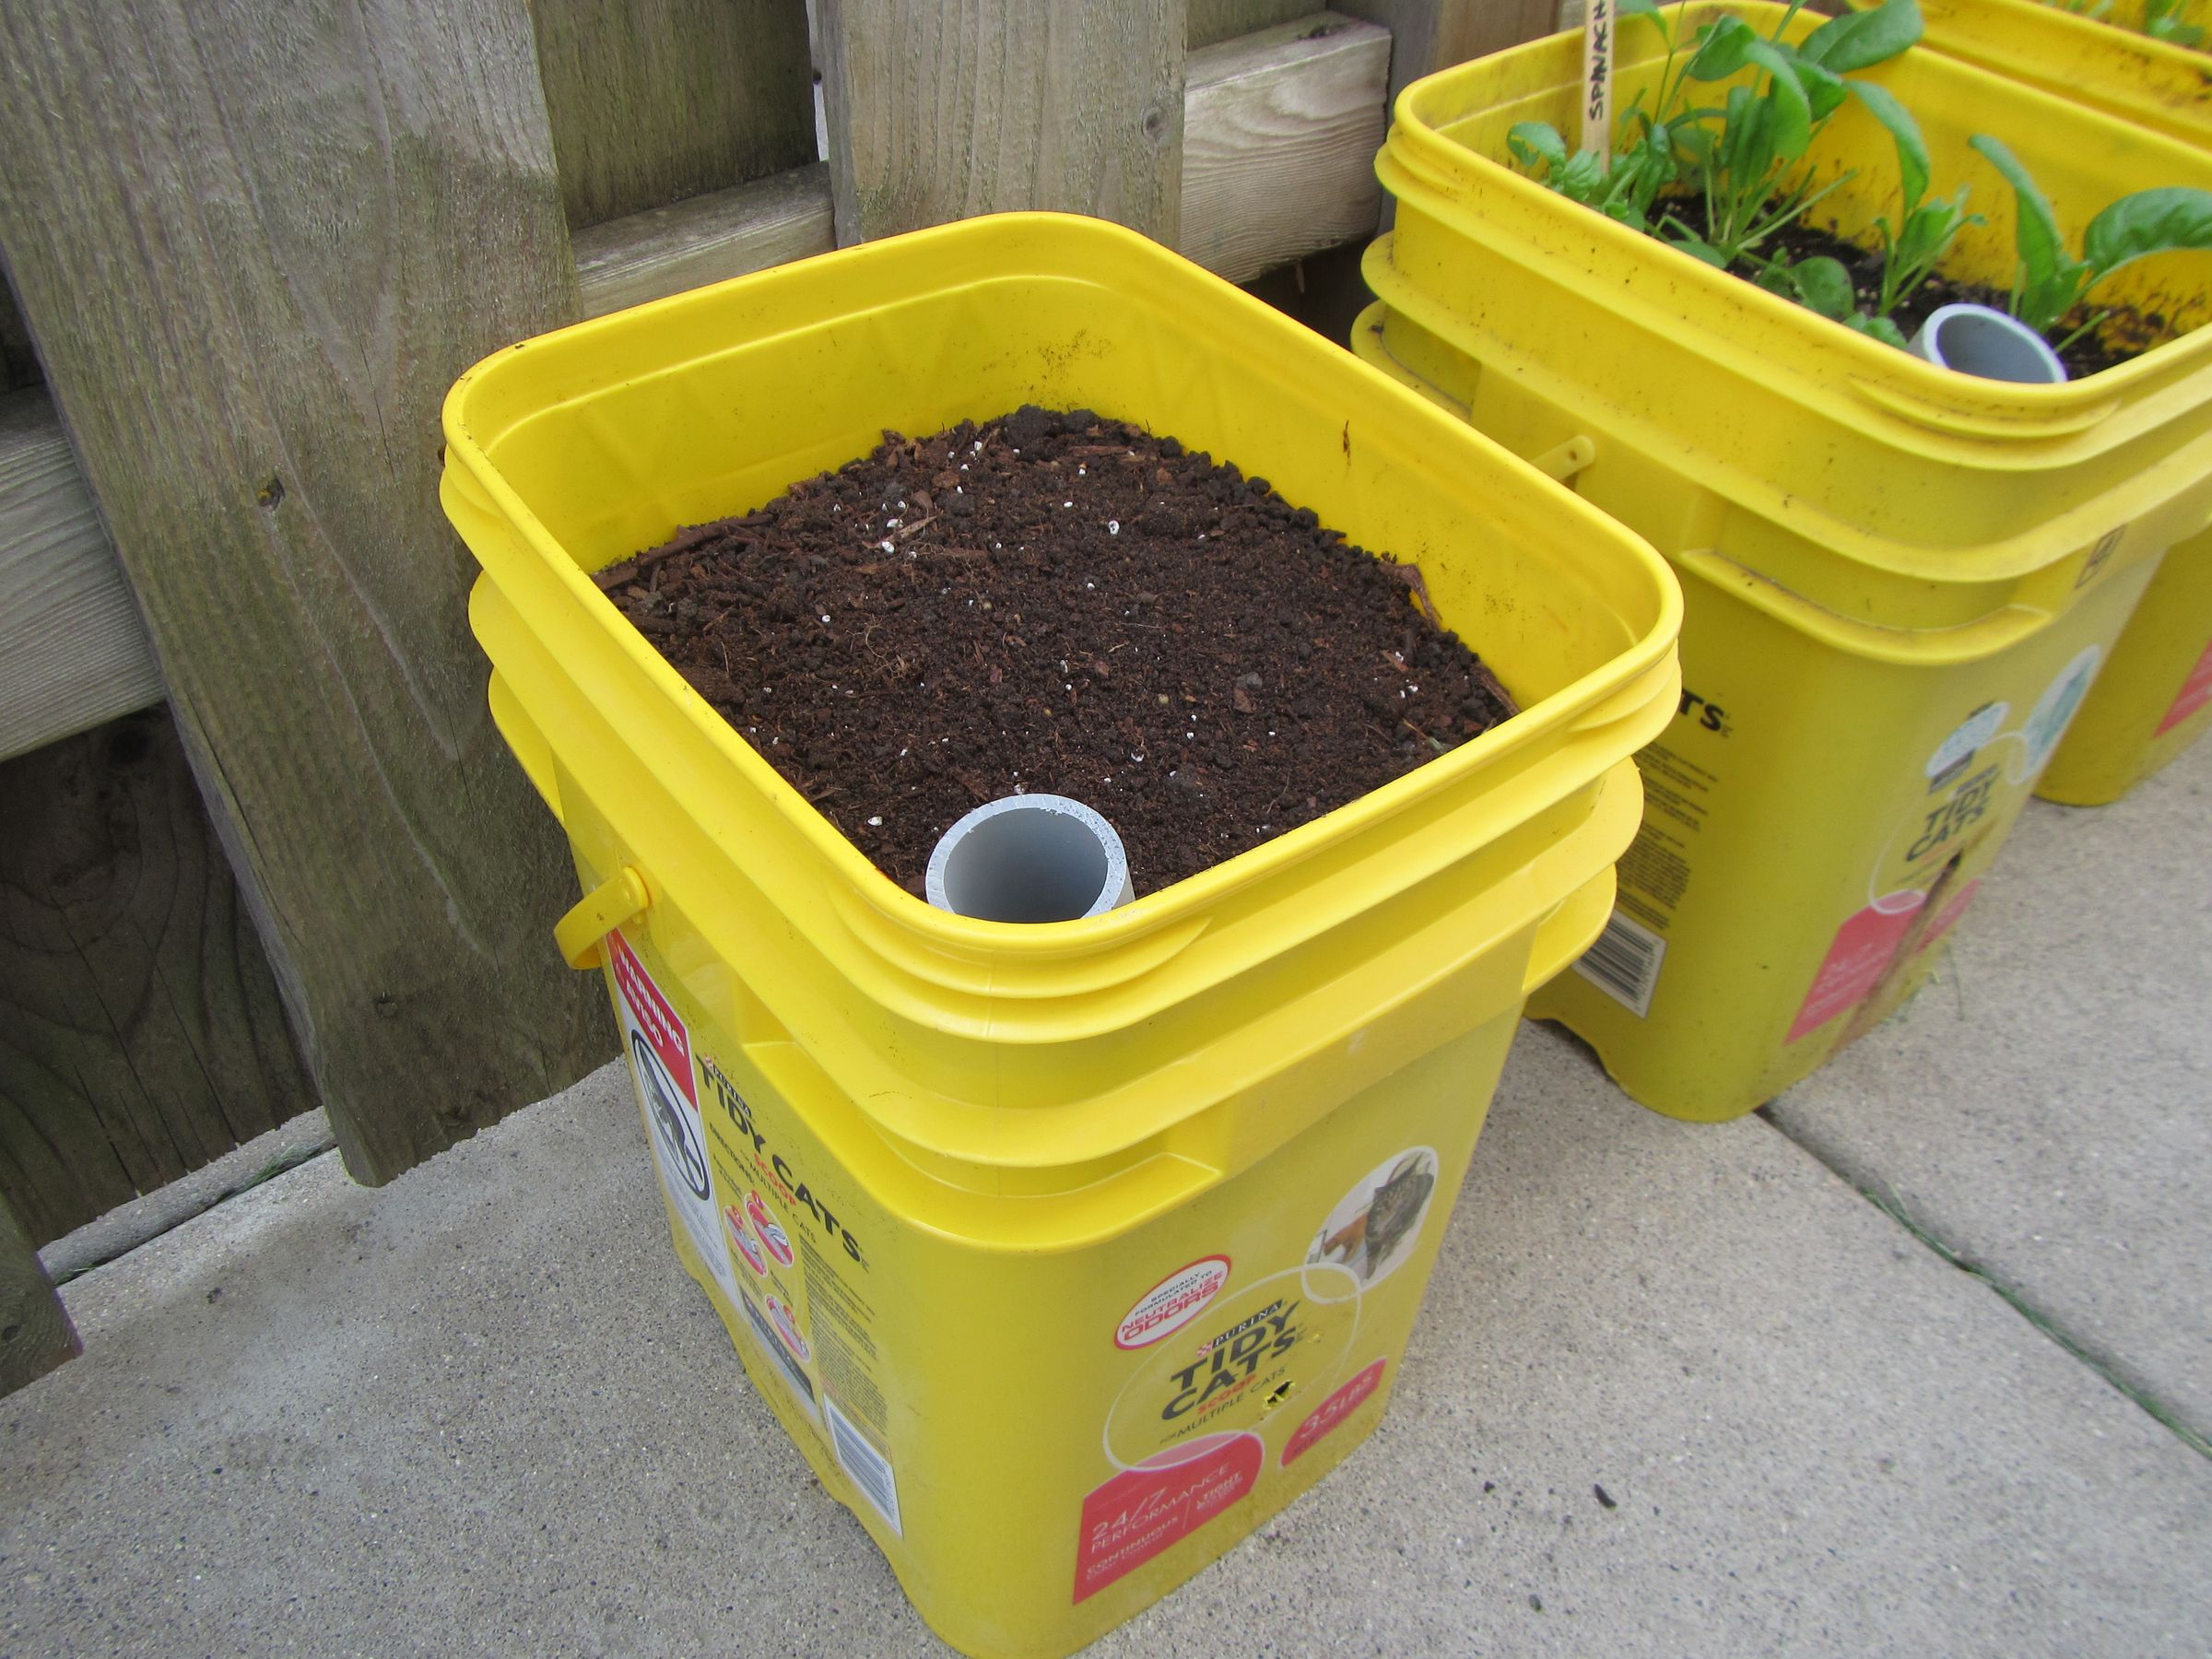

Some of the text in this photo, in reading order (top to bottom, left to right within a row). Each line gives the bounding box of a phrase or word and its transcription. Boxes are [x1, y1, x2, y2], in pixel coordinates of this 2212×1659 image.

[618, 943, 685, 1057] WARNING
[696, 1053, 766, 1153] TIDY
[772, 1154, 860, 1262] CATS
[754, 1153, 796, 1206] SCOOP
[792, 1213, 817, 1243] CATS
[1122, 1270, 1223, 1332] NEUTRALIZE
[1124, 1281, 1218, 1341] ODORS
[1135, 1279, 1197, 1316] FORMULATED
[1151, 1272, 1199, 1302] SPECIALLY
[1171, 1300, 1300, 1391] TIDY
[1215, 1303, 1280, 1347] PURINA
[1161, 1327, 1296, 1420] CATS
[1176, 1393, 1244, 1439] MULTIPLE
[1250, 1365, 1287, 1394] CATS
[1197, 1373, 1256, 1415] SCOOP
[1090, 1464, 1230, 1554] PERFORMANCE
[1092, 1486, 1168, 1541] 24/7
[1087, 1516, 1179, 1574] CONTINUOUS
